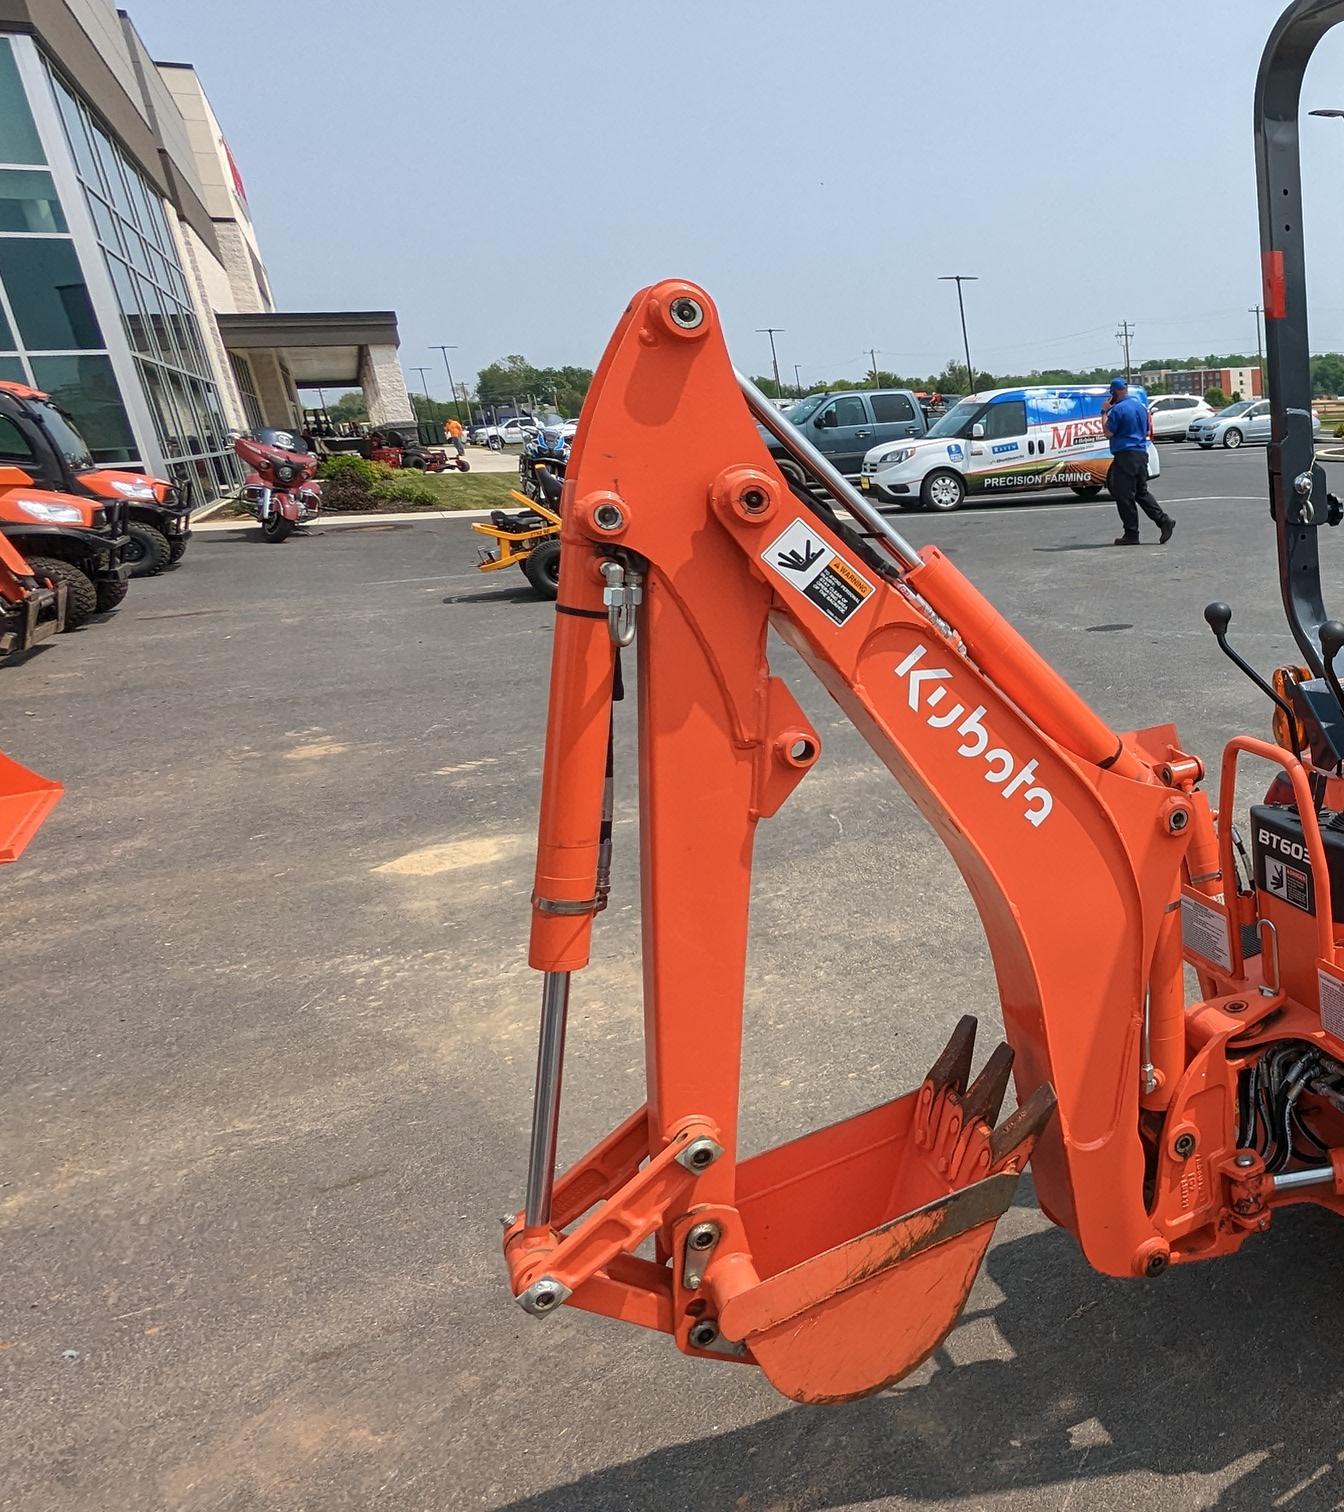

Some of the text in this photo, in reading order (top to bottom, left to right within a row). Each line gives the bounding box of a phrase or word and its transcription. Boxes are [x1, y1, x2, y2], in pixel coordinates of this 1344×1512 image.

[984, 472, 1092, 488] PRECISION FARMING
[838, 566, 869, 594] WARNING
[894, 644, 1053, 828] Kubota
